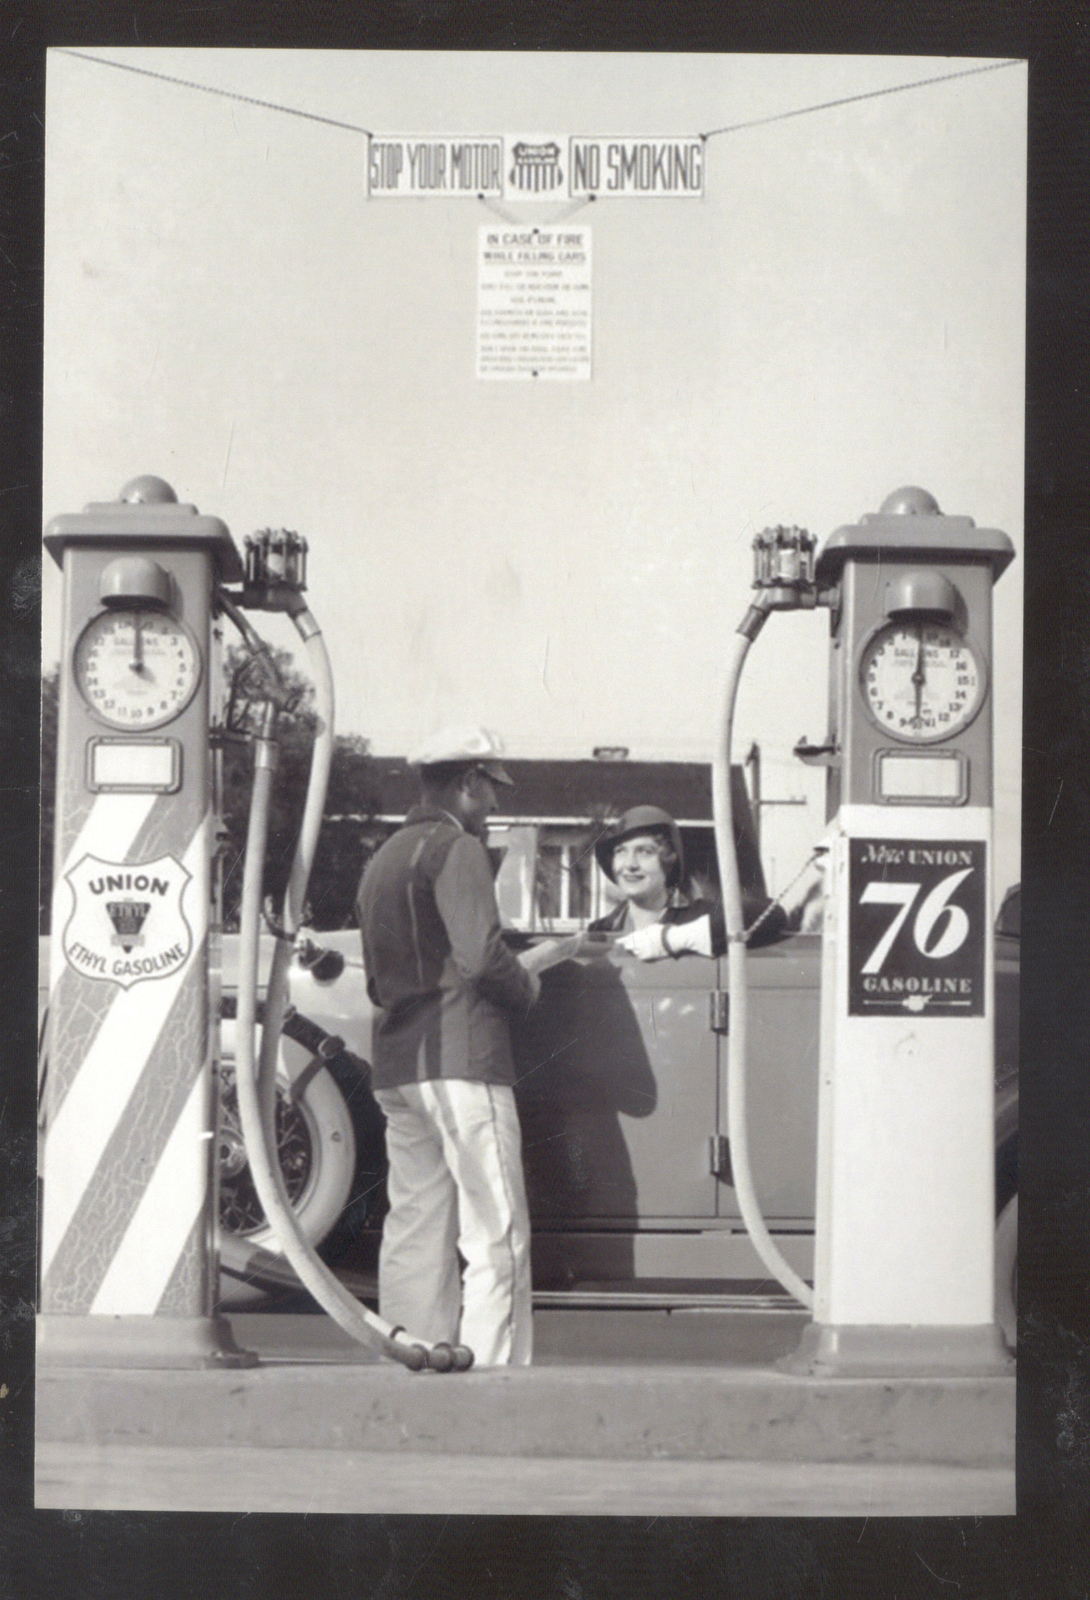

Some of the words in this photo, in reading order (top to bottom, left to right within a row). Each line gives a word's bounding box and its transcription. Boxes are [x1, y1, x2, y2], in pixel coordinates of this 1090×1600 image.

[371, 143, 403, 189] STOP
[407, 143, 446, 189] YOUR
[450, 143, 500, 189] MOTOR
[574, 144, 599, 190] NO
[607, 144, 701, 190] SMOKING
[487, 233, 499, 245] IN
[502, 233, 532, 245] CASE
[538, 234, 553, 245] OF
[557, 234, 584, 245] FIRE
[908, 850, 973, 865] UNION
[88, 873, 170, 896] UNION
[859, 867, 975, 974] 76
[68, 941, 107, 974] ETHYL
[112, 942, 186, 976] GASOLINE
[863, 977, 973, 993] GASOLINE
